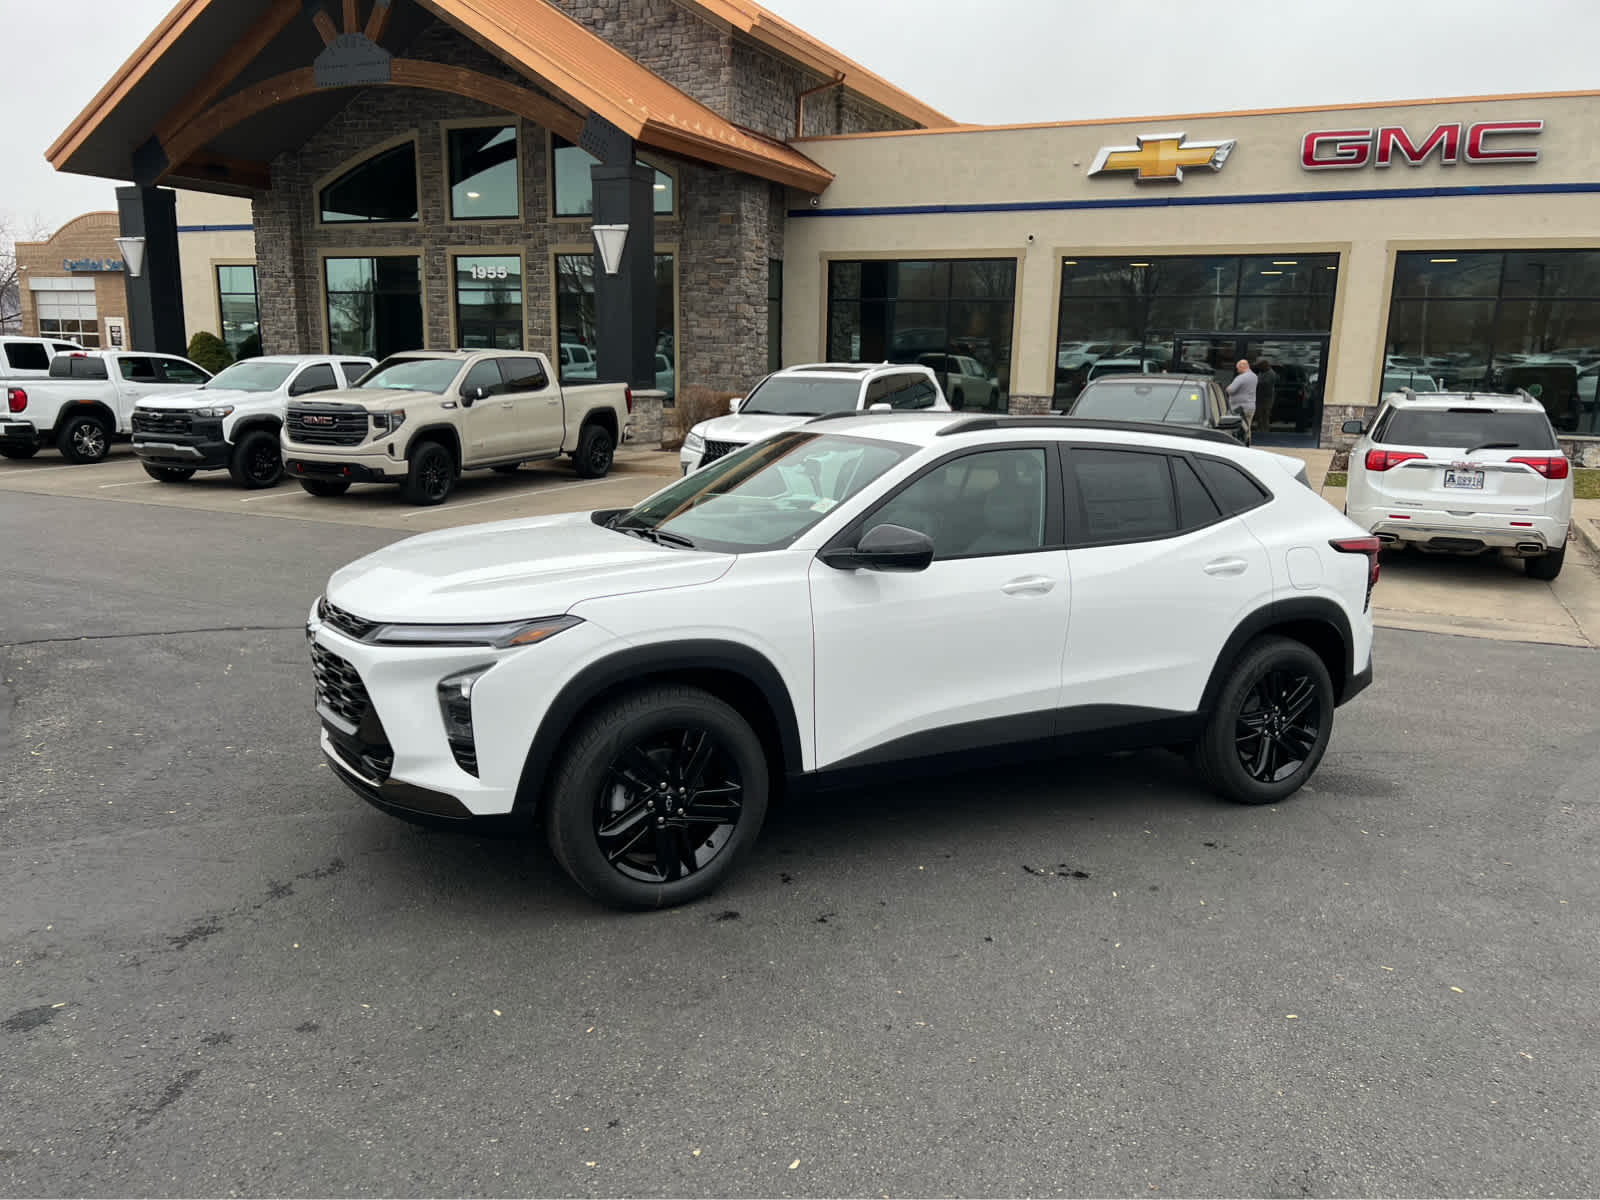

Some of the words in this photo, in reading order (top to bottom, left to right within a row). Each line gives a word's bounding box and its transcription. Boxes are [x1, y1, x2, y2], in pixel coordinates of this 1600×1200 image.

[1300, 119, 1545, 171] GMC
[471, 266, 508, 279] 1955
[303, 416, 333, 425] GMC
